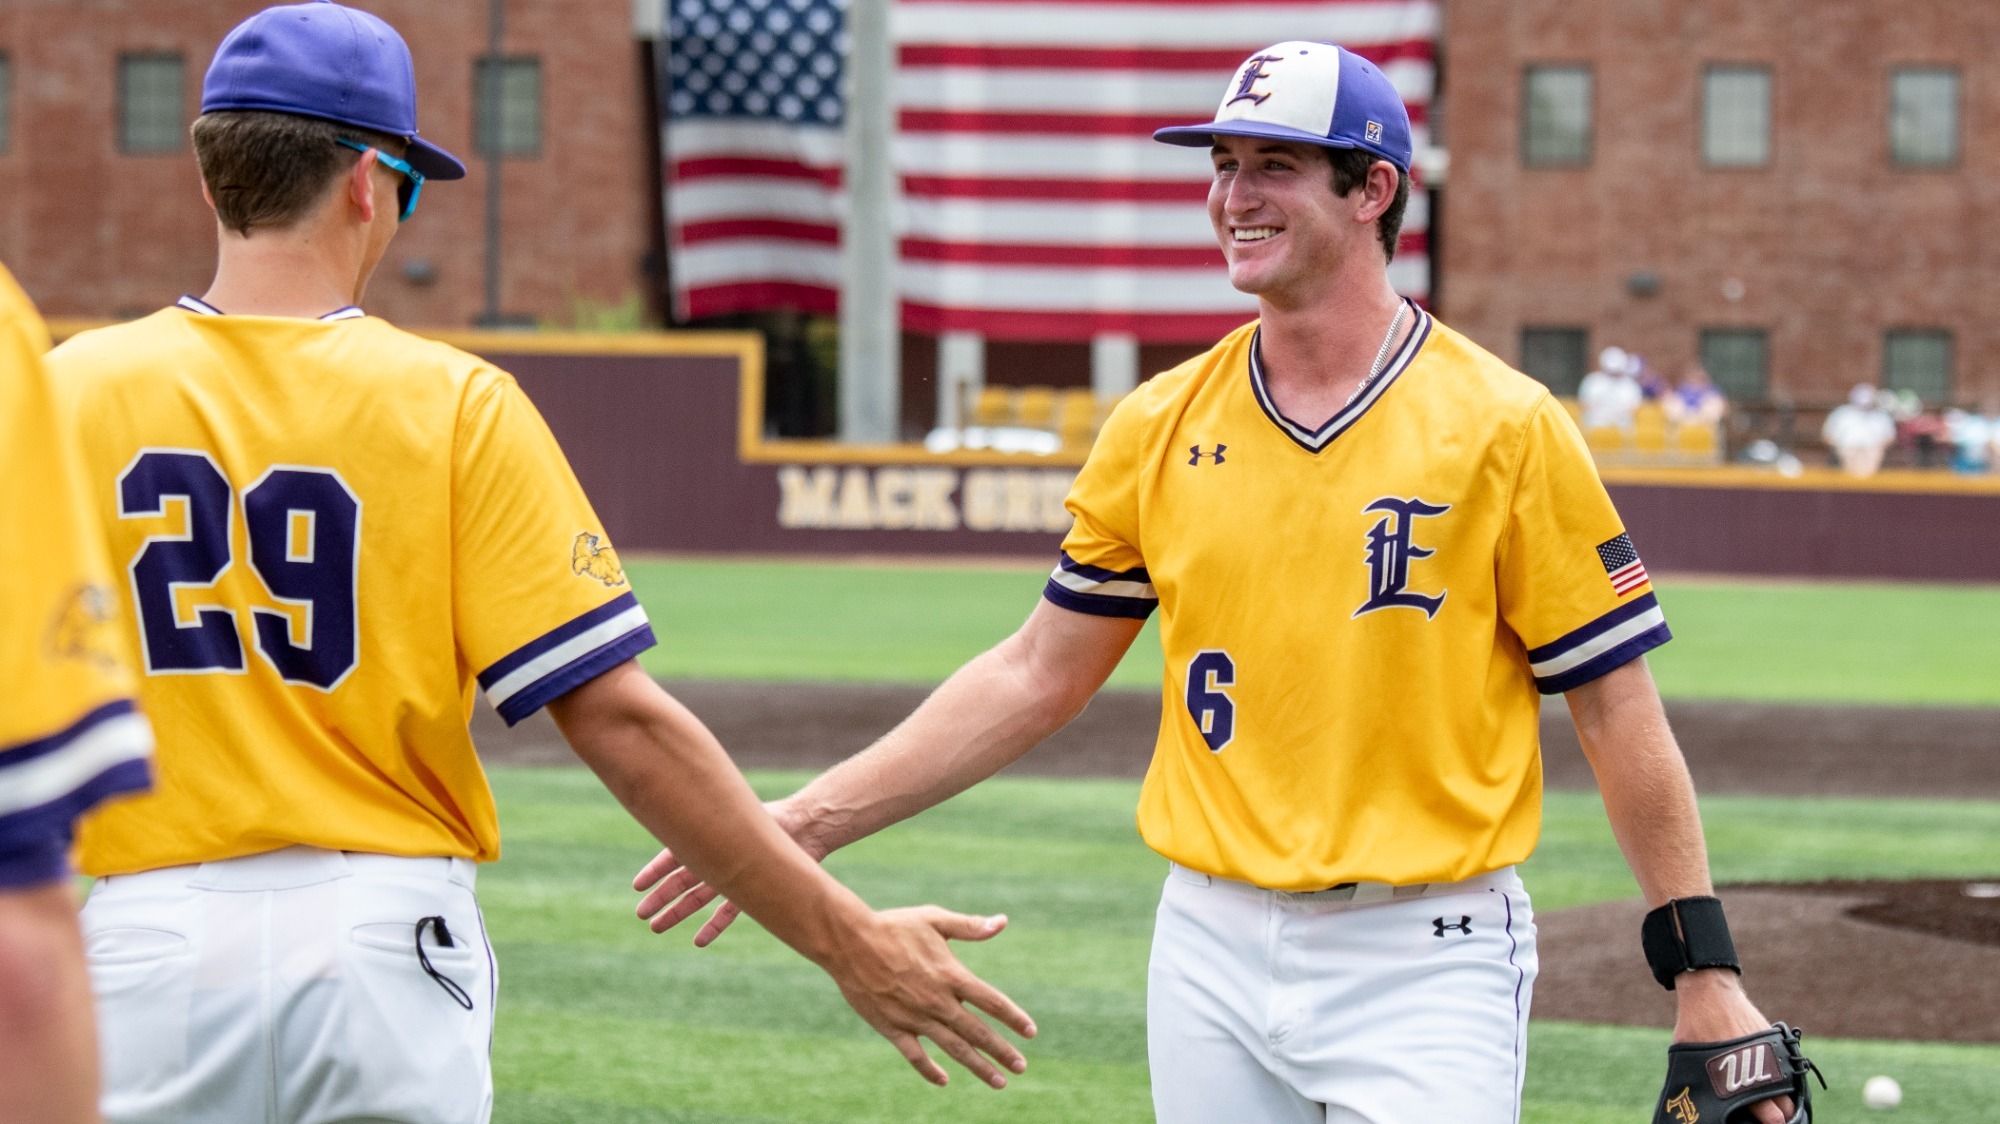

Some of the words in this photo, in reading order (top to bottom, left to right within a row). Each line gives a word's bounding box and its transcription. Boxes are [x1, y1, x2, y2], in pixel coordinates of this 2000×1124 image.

[1226, 54, 1284, 108] E
[778, 467, 959, 530] MACK
[116, 446, 363, 694] 29
[1350, 495, 1452, 622] E
[1185, 649, 1236, 754] 6
